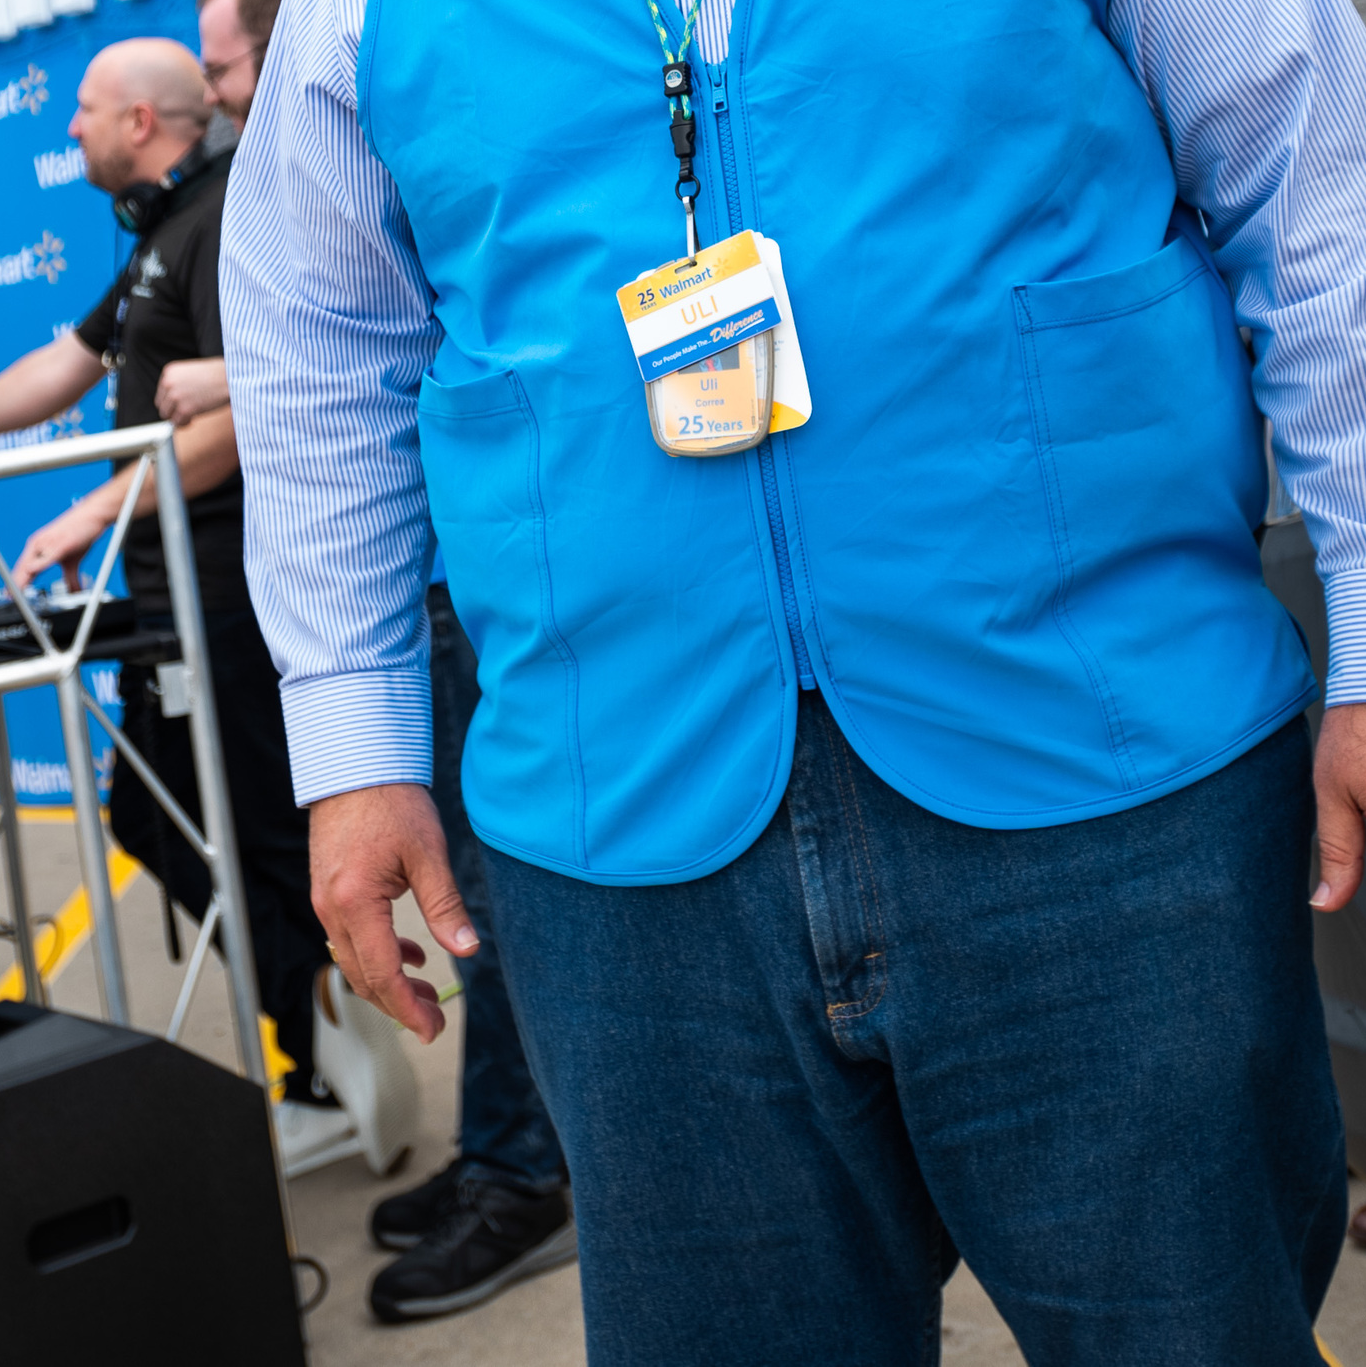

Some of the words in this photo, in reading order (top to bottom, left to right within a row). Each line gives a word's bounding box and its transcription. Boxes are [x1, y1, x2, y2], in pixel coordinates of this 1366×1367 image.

[637, 288, 655, 306] 25
[659, 267, 713, 299] Walmart
[641, 302, 657, 311] YEARS
[681, 295, 718, 325] ULI
[652, 360, 662, 368] Our
[663, 350, 682, 363] People
[682, 344, 696, 354] Make
[710, 309, 764, 343] Difference
[700, 378, 718, 392] Uli
[695, 398, 725, 408] Correa
[678, 415, 704, 435] 25
[707, 420, 744, 433] Years
